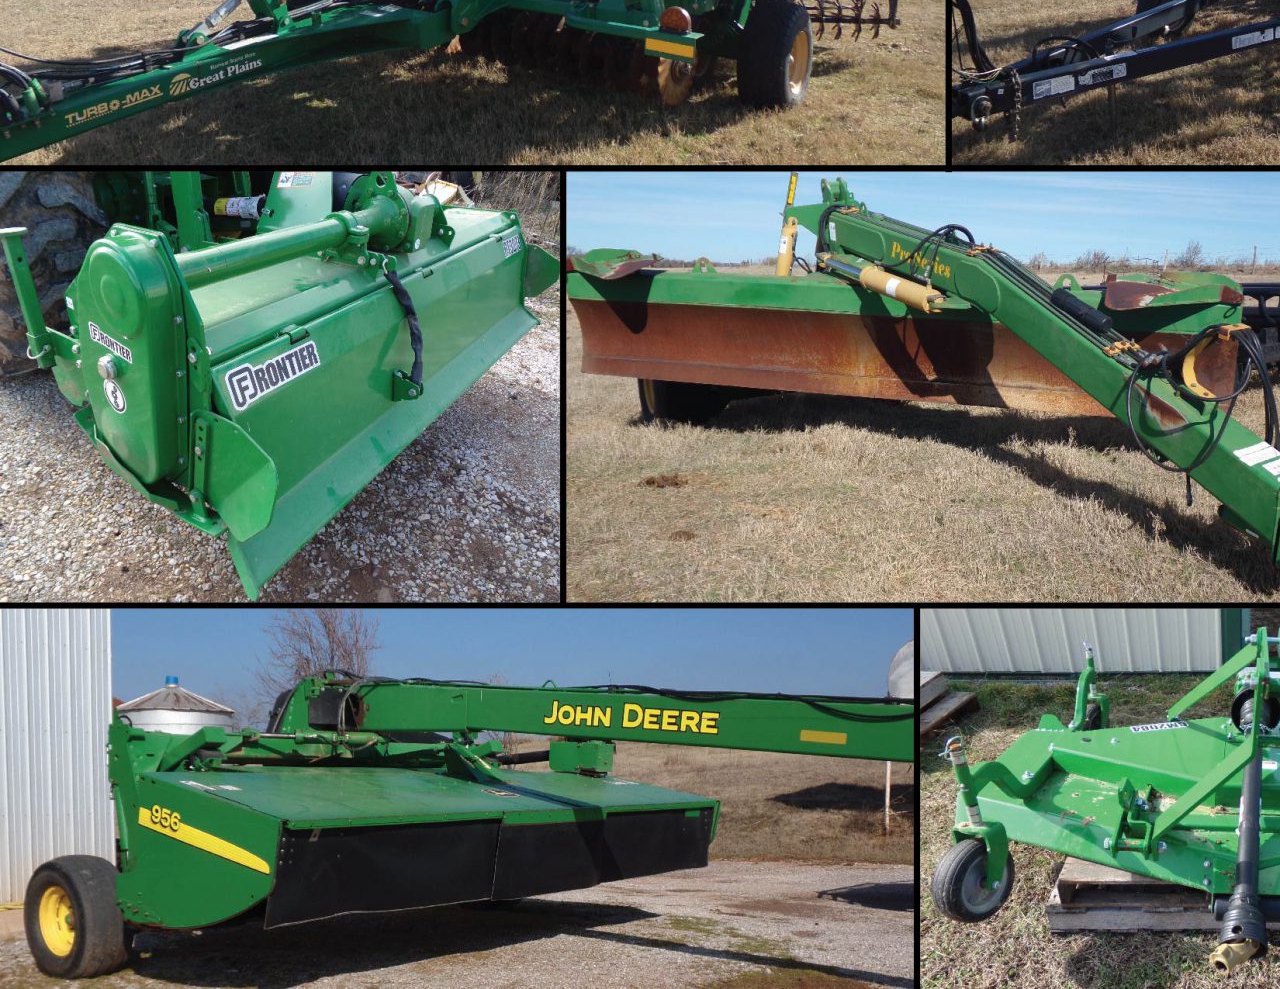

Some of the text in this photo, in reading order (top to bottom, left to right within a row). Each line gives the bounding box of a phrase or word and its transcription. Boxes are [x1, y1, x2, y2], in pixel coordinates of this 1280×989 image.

[189, 58, 262, 90] Great Plains
[89, 322, 132, 362] FRONTIER
[227, 343, 319, 408] FRONTIER
[544, 700, 721, 734] JOHN DEERE
[151, 804, 181, 832] 956
